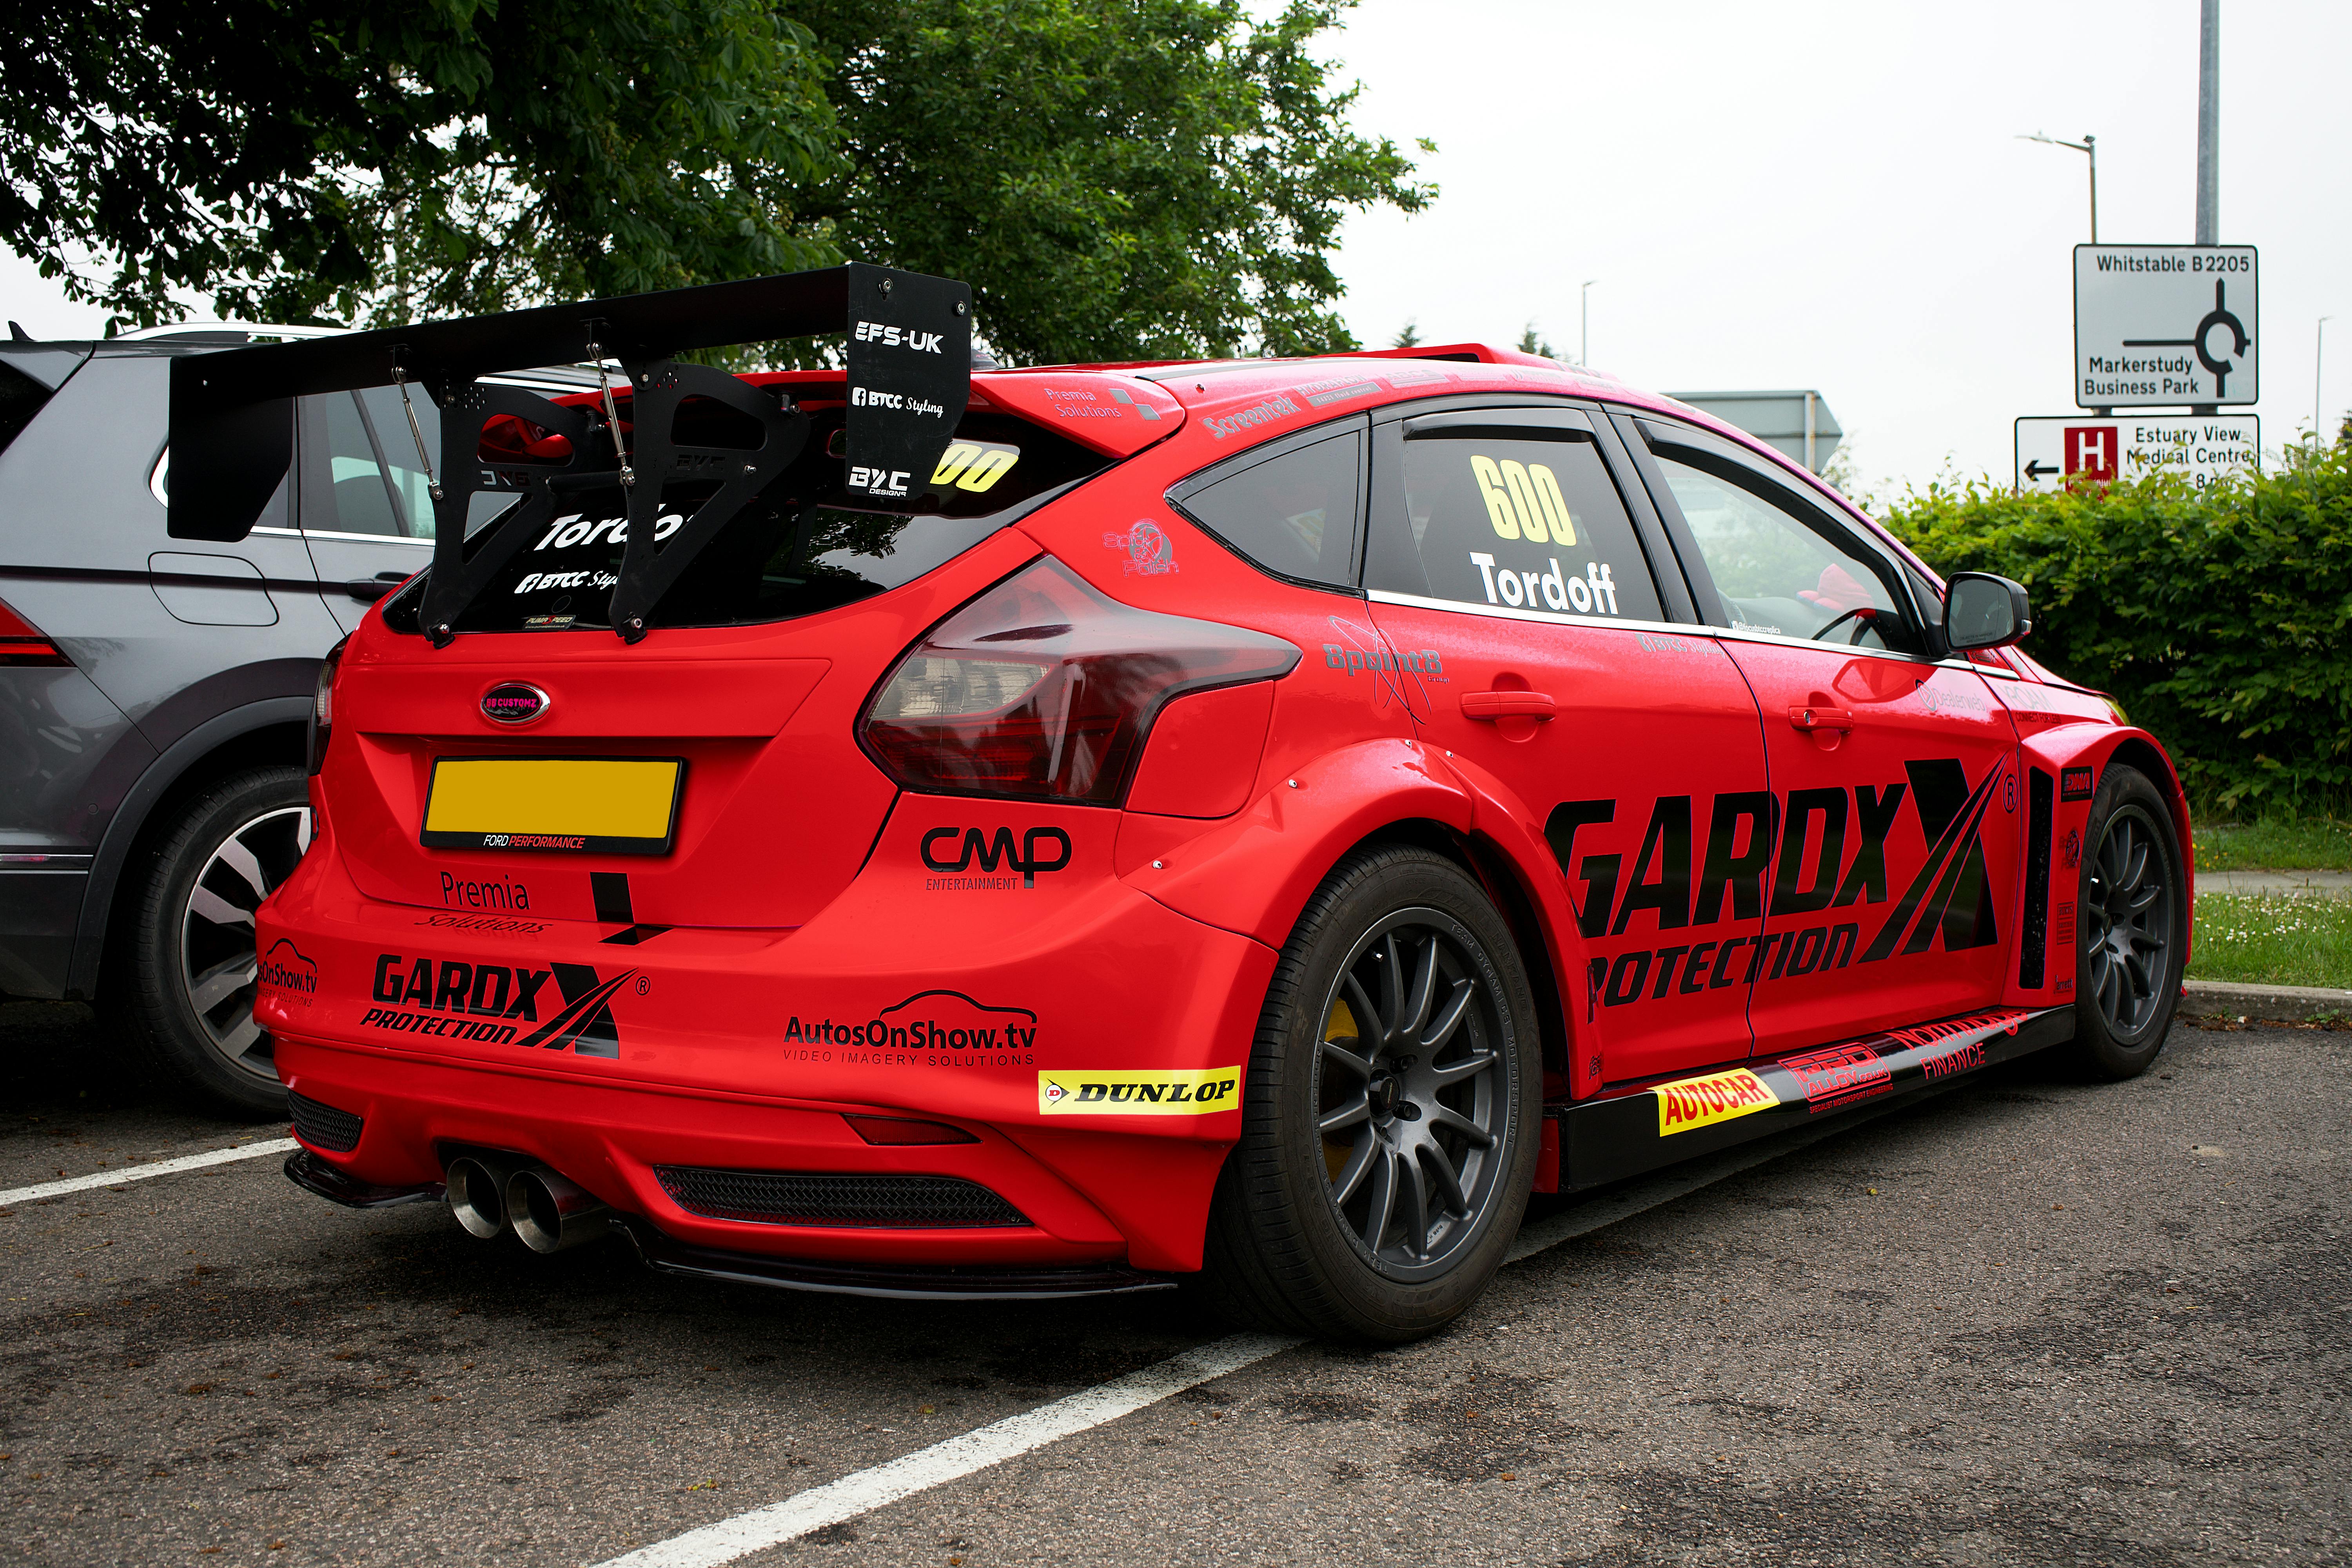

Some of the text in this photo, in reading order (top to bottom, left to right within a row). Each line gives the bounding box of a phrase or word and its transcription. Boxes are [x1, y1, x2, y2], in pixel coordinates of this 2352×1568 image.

[2096, 254, 2249, 272] Whitstable B2205
[855, 321, 944, 354] EFS-UK
[2089, 356, 2193, 375] Markerstudy
[1044, 388, 1096, 401] Premia
[1293, 374, 1368, 396] HYDRAFLOW
[1351, 386, 1372, 395] control
[2084, 377, 2199, 396] Business Park
[869, 391, 944, 418] BTCC Styling
[1055, 404, 1122, 418] Solutions
[1202, 394, 1302, 439] Screentek
[2136, 426, 2241, 445] Estuary View
[2196, 448, 2250, 464] Centre
[1470, 455, 1577, 546] 600
[1123, 558, 1179, 577] Polish
[535, 571, 590, 590] BTCC
[1469, 552, 1619, 615] Tordoff
[526, 615, 573, 625] PUMASPEED
[1650, 636, 1725, 659] BTCC Styling
[1322, 644, 1442, 677] 8point8
[1427, 675, 1449, 684] Group
[497, 698, 537, 708] CUSTOMZ
[1932, 688, 1986, 711] Dealerweb
[483, 835, 586, 849] FORD PERFORMANCE
[920, 826, 1073, 889] CMP
[1543, 782, 1908, 938] GARDX
[440, 871, 530, 910] Premia
[926, 877, 1018, 891] ENTERTAINMENT
[414, 913, 554, 933] Solutions
[277, 991, 313, 1007] SOLUTIONS
[372, 953, 552, 1023] GARDX
[359, 1007, 518, 1045] PROTECTION
[783, 1015, 1038, 1050] AutosOnShow.tv
[1450, 921, 1520, 1147] TEAM DYNAMICS MOTORSPORT
[783, 1049, 1034, 1067] VIDEO IMAGERY SOLUTIONS
[1786, 1045, 1878, 1083] PRO
[1919, 1042, 1986, 1080] FINANCE
[1074, 1079, 1236, 1103] DUNLOP
[1665, 1071, 1773, 1126] AUTOCAR
[1809, 1083, 1893, 1114] SPECIALIST MOTORSPORT ENGINEERING
